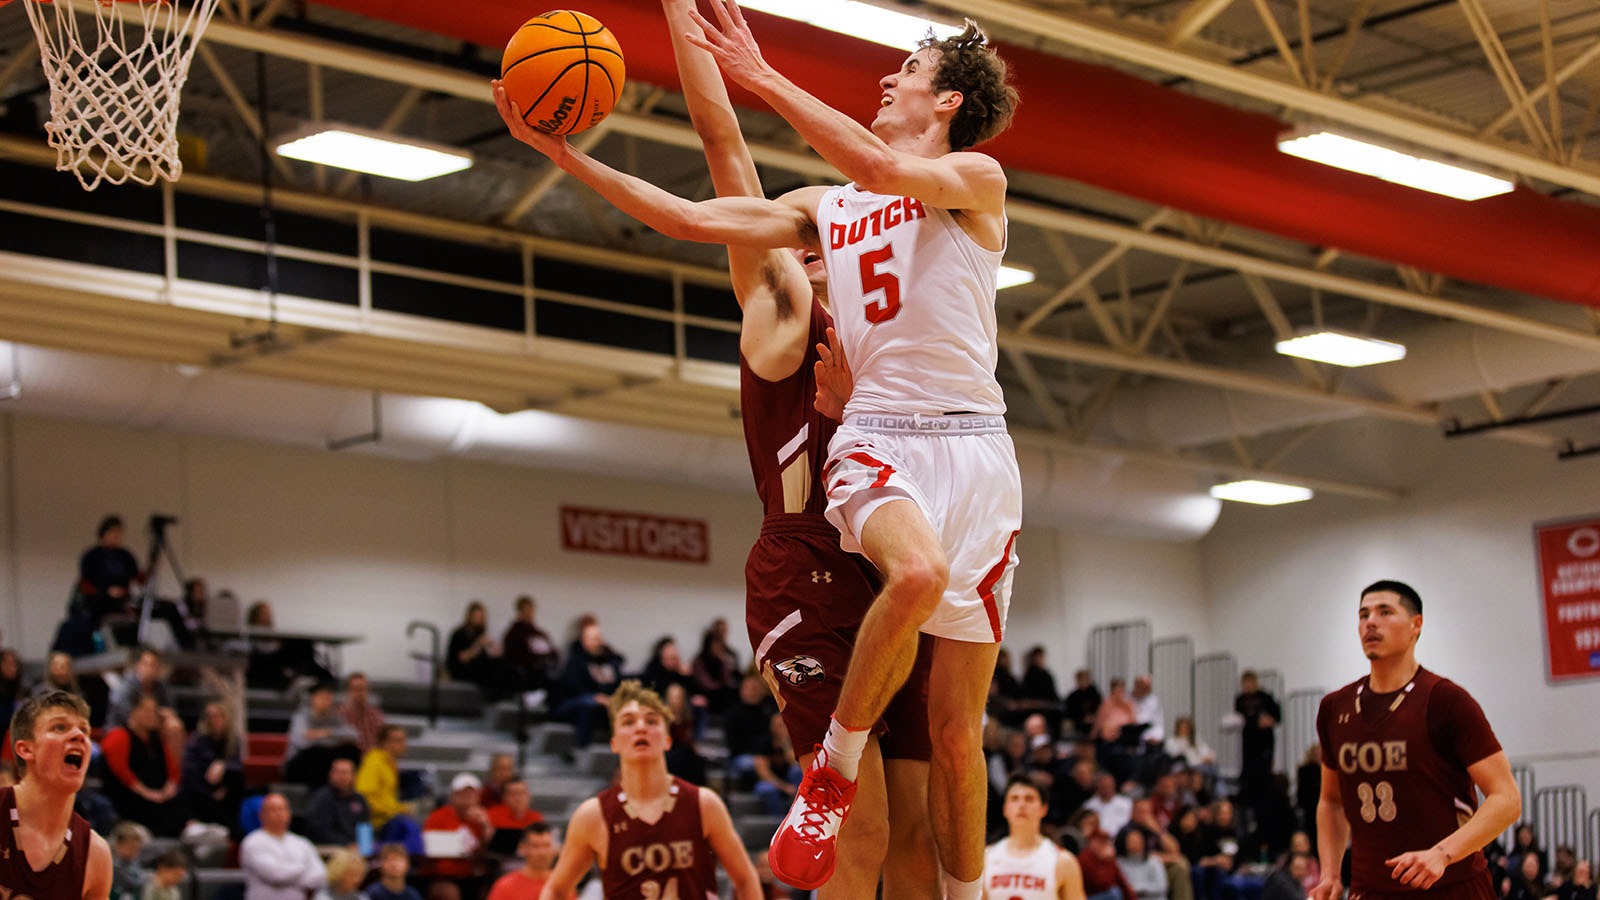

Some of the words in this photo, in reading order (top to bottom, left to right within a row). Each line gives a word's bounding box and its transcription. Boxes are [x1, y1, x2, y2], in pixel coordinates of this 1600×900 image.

[537, 96, 577, 133] lson
[830, 196, 927, 251] DUTCH
[858, 241, 903, 326] 5
[958, 417, 1004, 430] DER
[563, 510, 703, 558] VISITORS
[1338, 740, 1408, 774] COE
[621, 840, 694, 876] COE
[991, 873, 1047, 892] DUTCH
